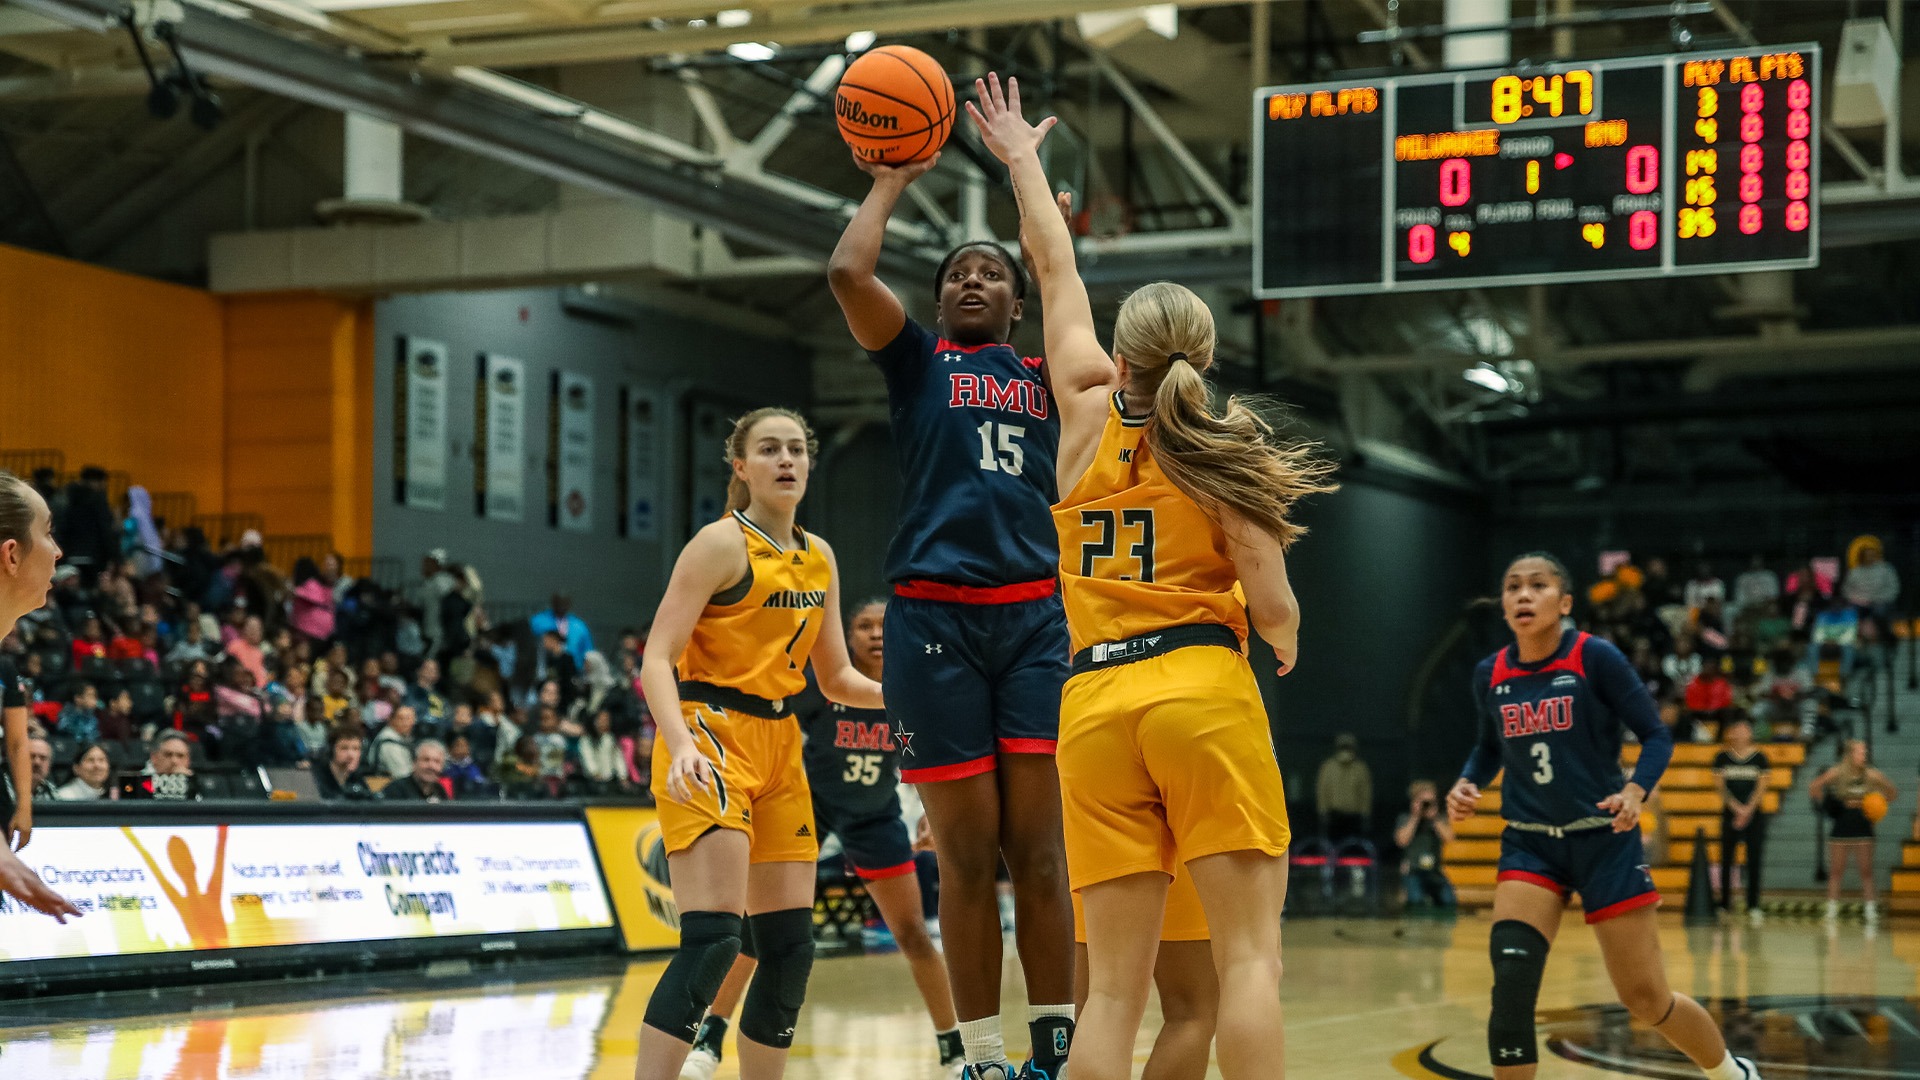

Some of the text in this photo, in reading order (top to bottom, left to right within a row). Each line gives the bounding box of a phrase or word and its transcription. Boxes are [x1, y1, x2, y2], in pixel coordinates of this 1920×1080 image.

[837, 93, 899, 130] Wilson
[1491, 69, 1593, 124] 8:47
[1697, 78, 1811, 118] 3 0 0
[1694, 109, 1811, 144] 4 0 0
[1626, 145, 1659, 194] 0
[1740, 143, 1764, 174] 0
[1786, 139, 1810, 171] 0
[1440, 158, 1471, 207] 0
[1526, 160, 1540, 195] 1
[1685, 169, 1809, 206] 15 0 0
[1629, 210, 1657, 250] 0
[1677, 200, 1809, 238] 35 0 0
[1409, 224, 1435, 264] 0
[949, 372, 1048, 420] RMU
[976, 420, 1026, 477] 15
[1079, 508, 1156, 584] 23
[1500, 695, 1575, 738] RMU
[842, 753, 883, 786] 35
[1530, 742, 1555, 785] 3
[357, 840, 460, 882] Chiropractic
[384, 883, 457, 920] Company
